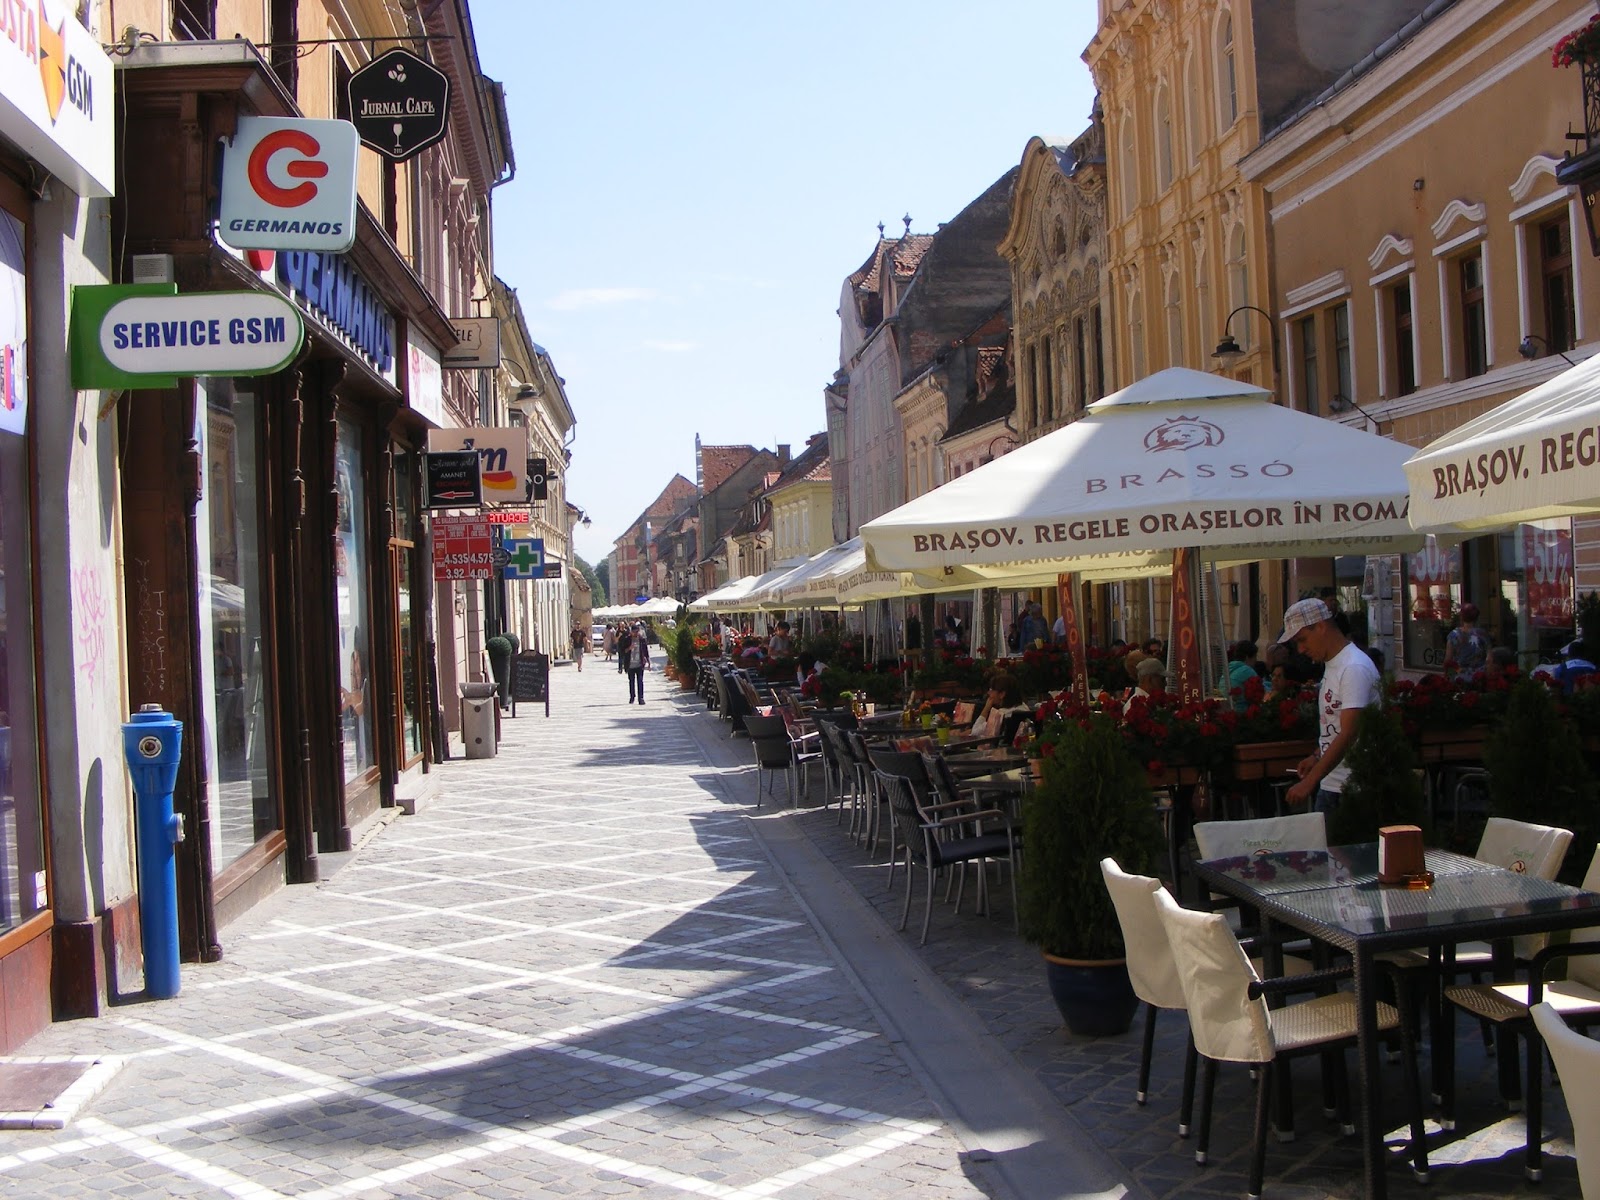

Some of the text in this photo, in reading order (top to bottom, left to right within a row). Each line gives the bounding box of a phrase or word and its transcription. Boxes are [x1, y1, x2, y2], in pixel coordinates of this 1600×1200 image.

[67, 54, 93, 122] GSM
[361, 99, 403, 115] JURNAL
[229, 219, 343, 235] GERMANOS
[113, 317, 286, 349] SERVICE GSM
[459, 438, 507, 471] m
[1540, 424, 1600, 475] REG
[440, 471, 467, 479] AMANET
[1086, 459, 1294, 494] BRASSÓ
[1034, 518, 1130, 544] REGELE
[1139, 506, 1284, 535] ORAȘELOR
[1293, 501, 1322, 525] ÎN
